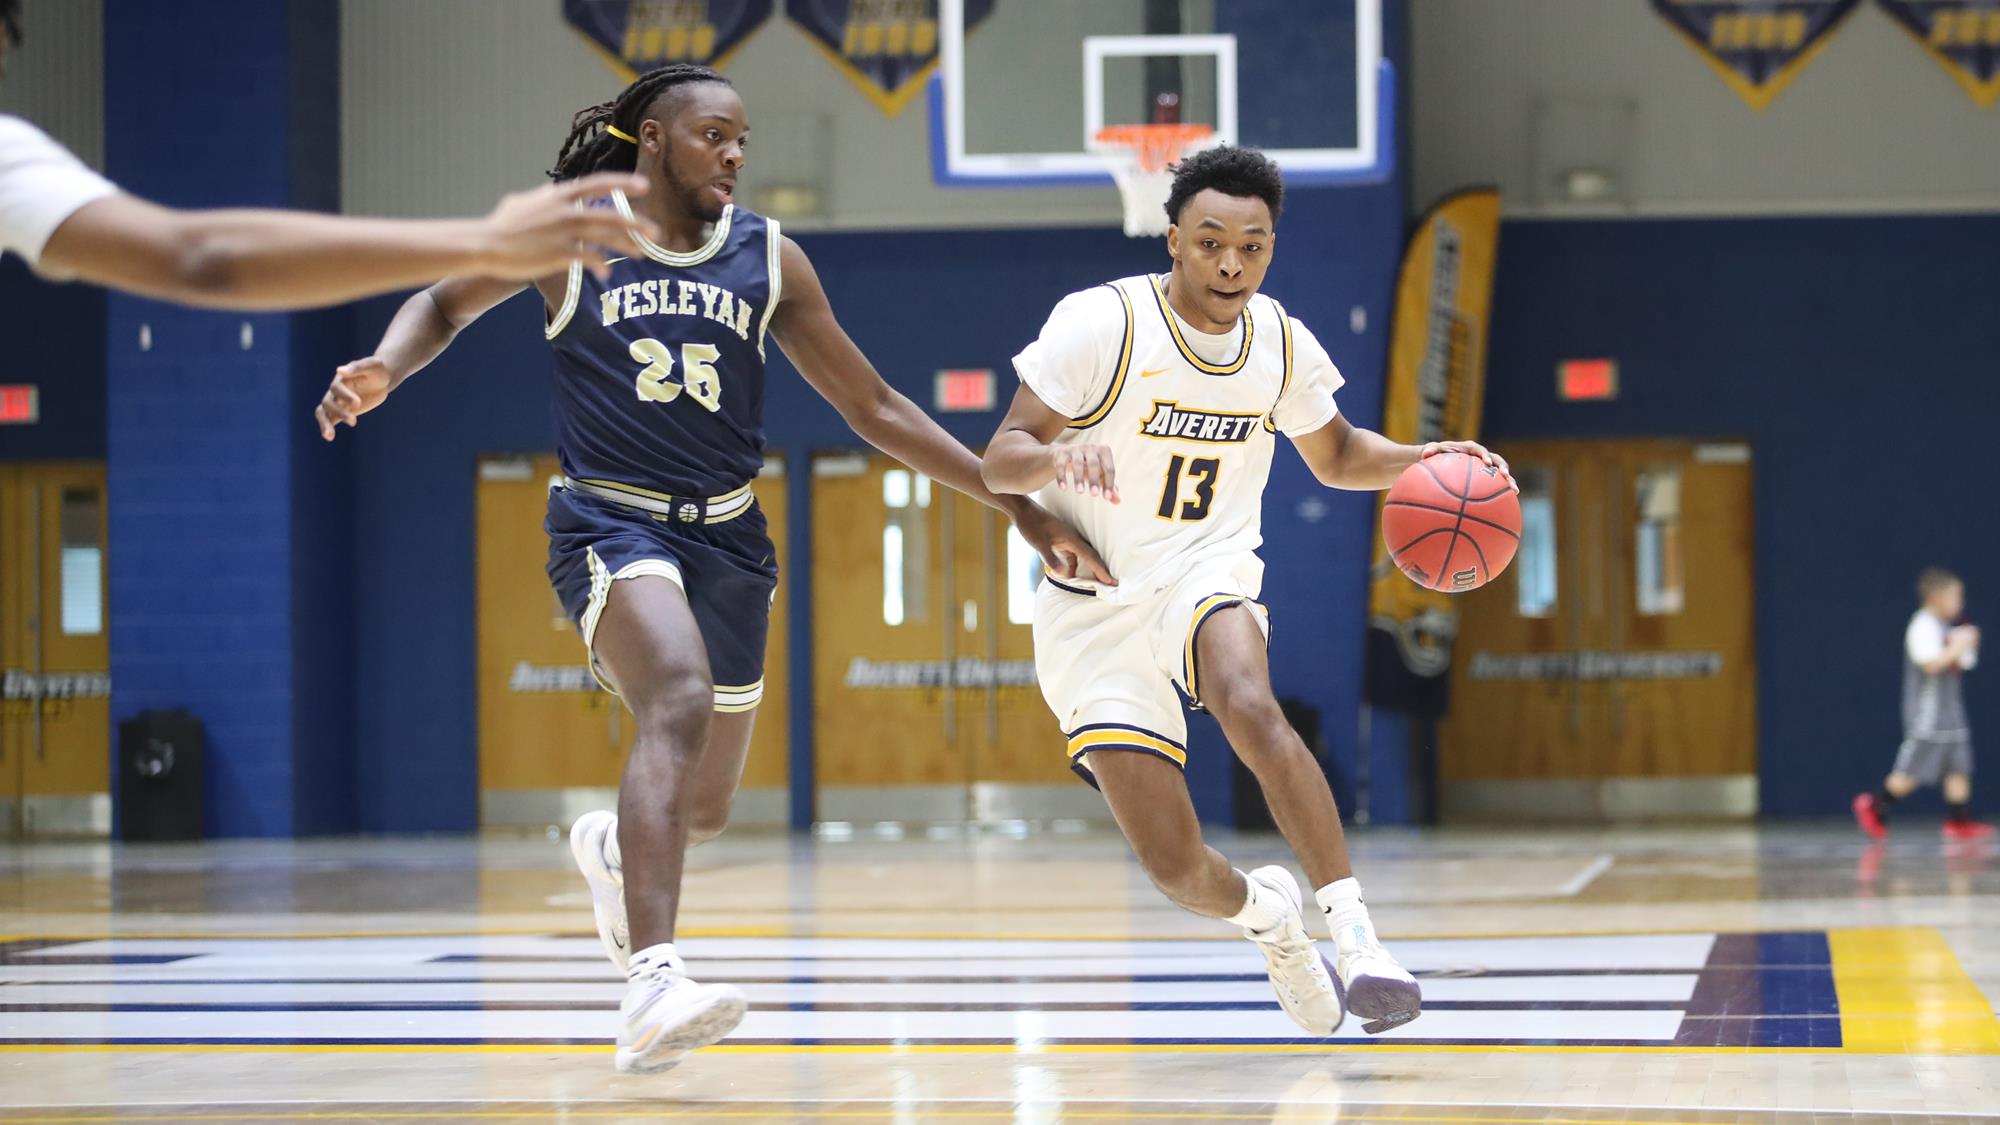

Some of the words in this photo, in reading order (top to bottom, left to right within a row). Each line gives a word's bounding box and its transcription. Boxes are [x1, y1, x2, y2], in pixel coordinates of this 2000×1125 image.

[600, 279, 753, 341] WESLEYAN
[1142, 401, 1262, 442] AVERETT
[1156, 454, 1222, 523] 13
